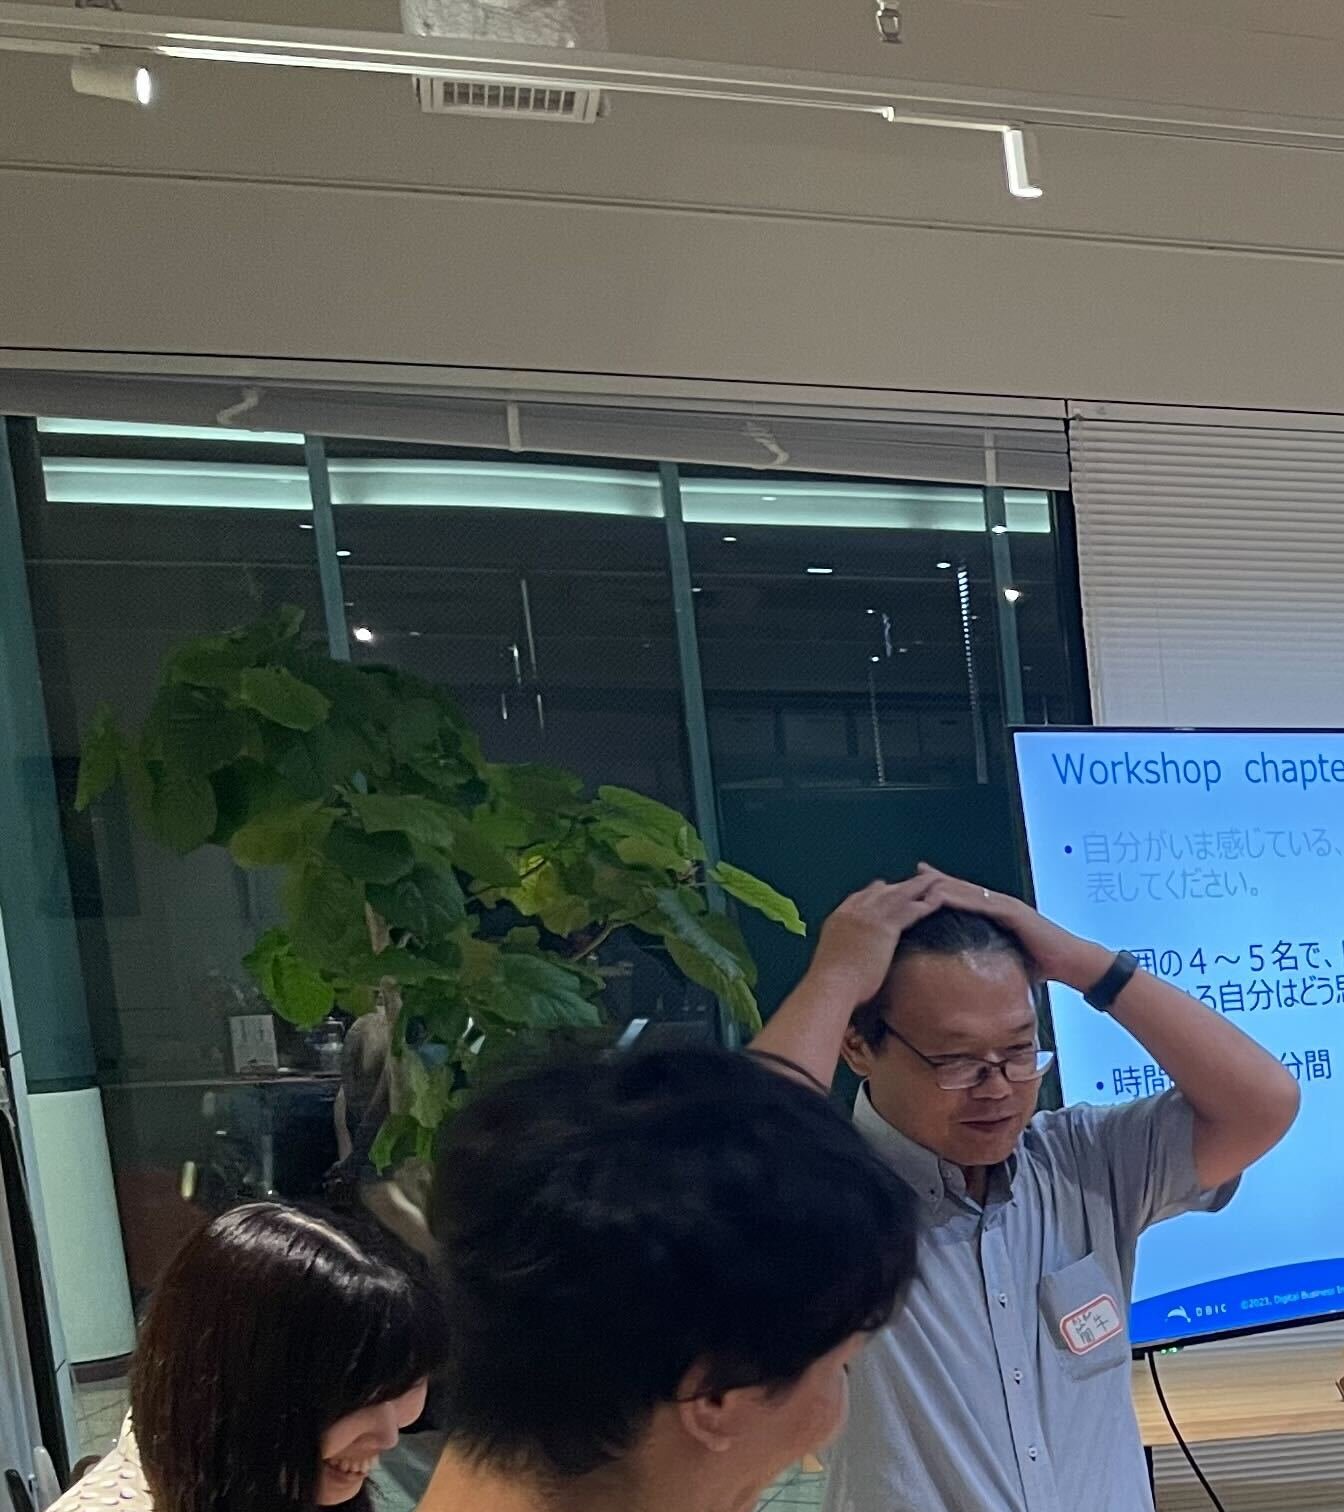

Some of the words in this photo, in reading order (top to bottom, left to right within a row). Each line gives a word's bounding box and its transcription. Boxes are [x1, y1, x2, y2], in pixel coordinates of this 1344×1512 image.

[1051, 752, 1222, 791] Workshop
[1086, 867, 1259, 903] 表してください。
[1112, 1064, 1171, 1097] 時間
[1280, 1049, 1331, 1081] 分間
